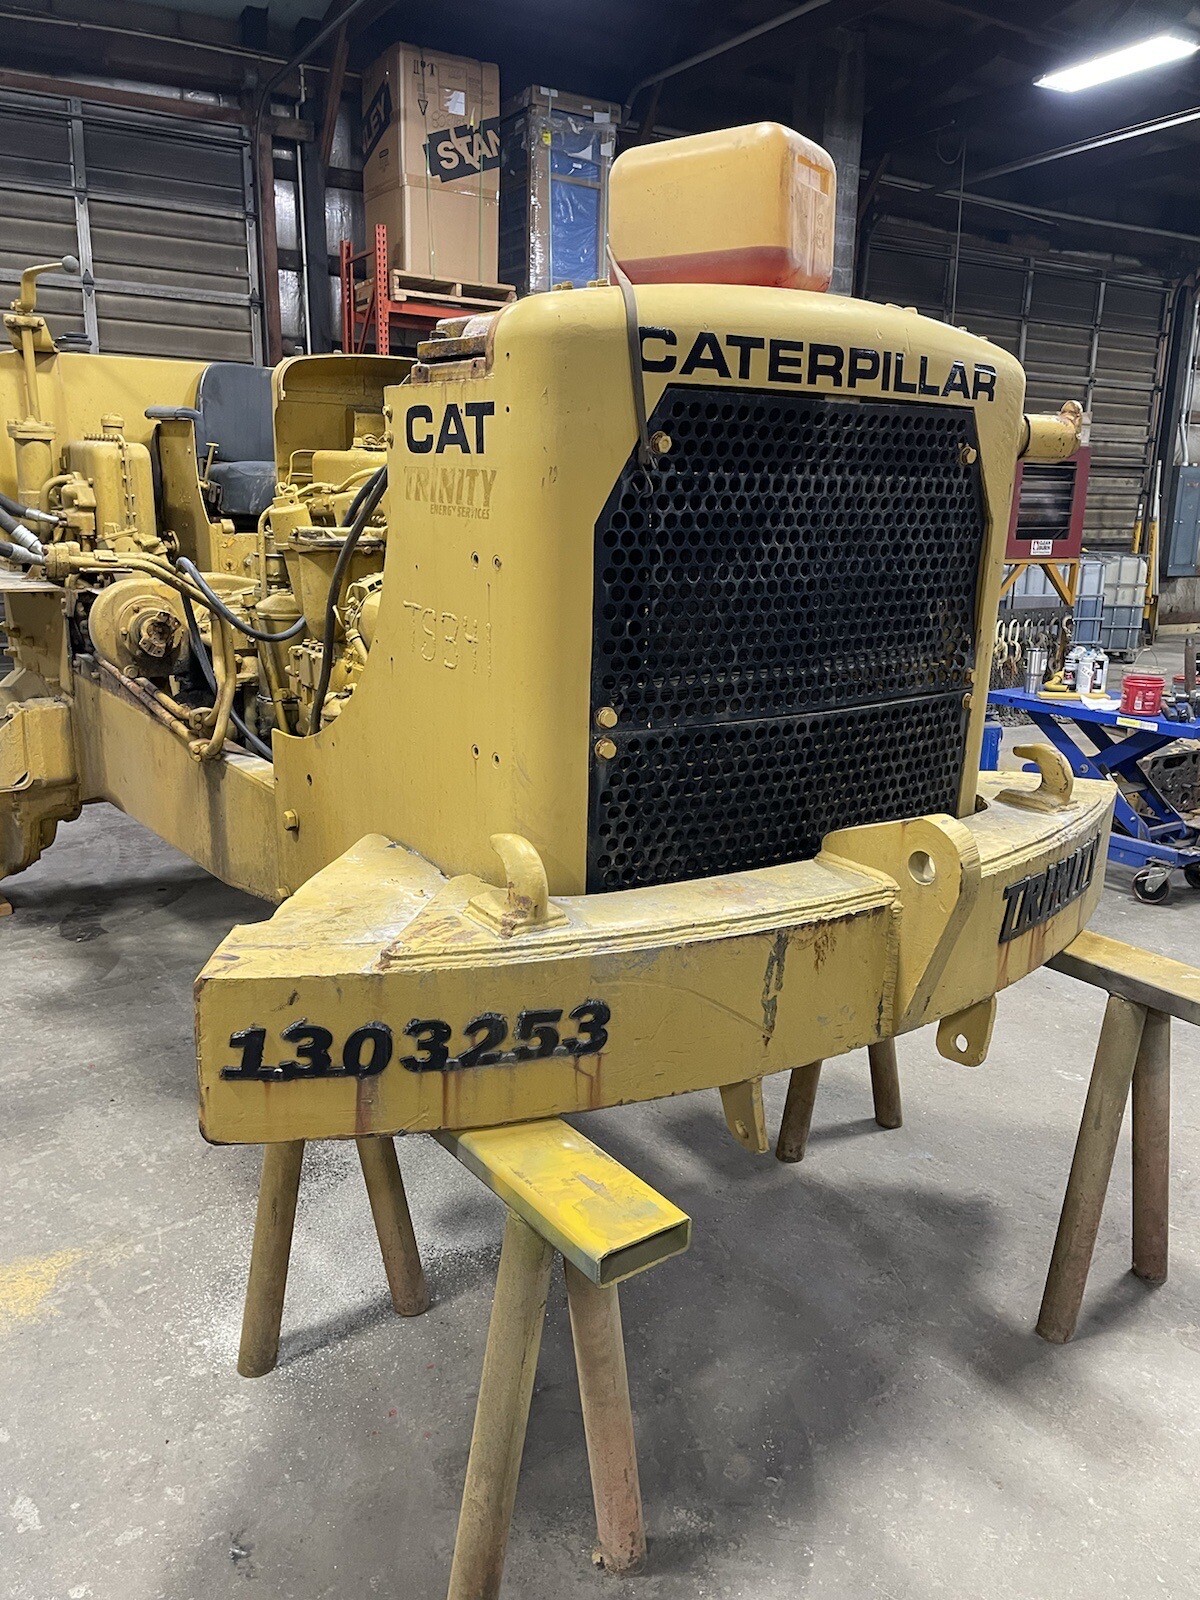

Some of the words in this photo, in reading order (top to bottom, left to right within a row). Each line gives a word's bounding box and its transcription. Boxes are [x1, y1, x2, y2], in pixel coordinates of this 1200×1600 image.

[639, 326, 997, 402] CATERPILLAR
[406, 401, 495, 454] CAT
[403, 466, 497, 507] TRINITY
[430, 504, 457, 516] ENERGY
[457, 506, 490, 520] SERVICES
